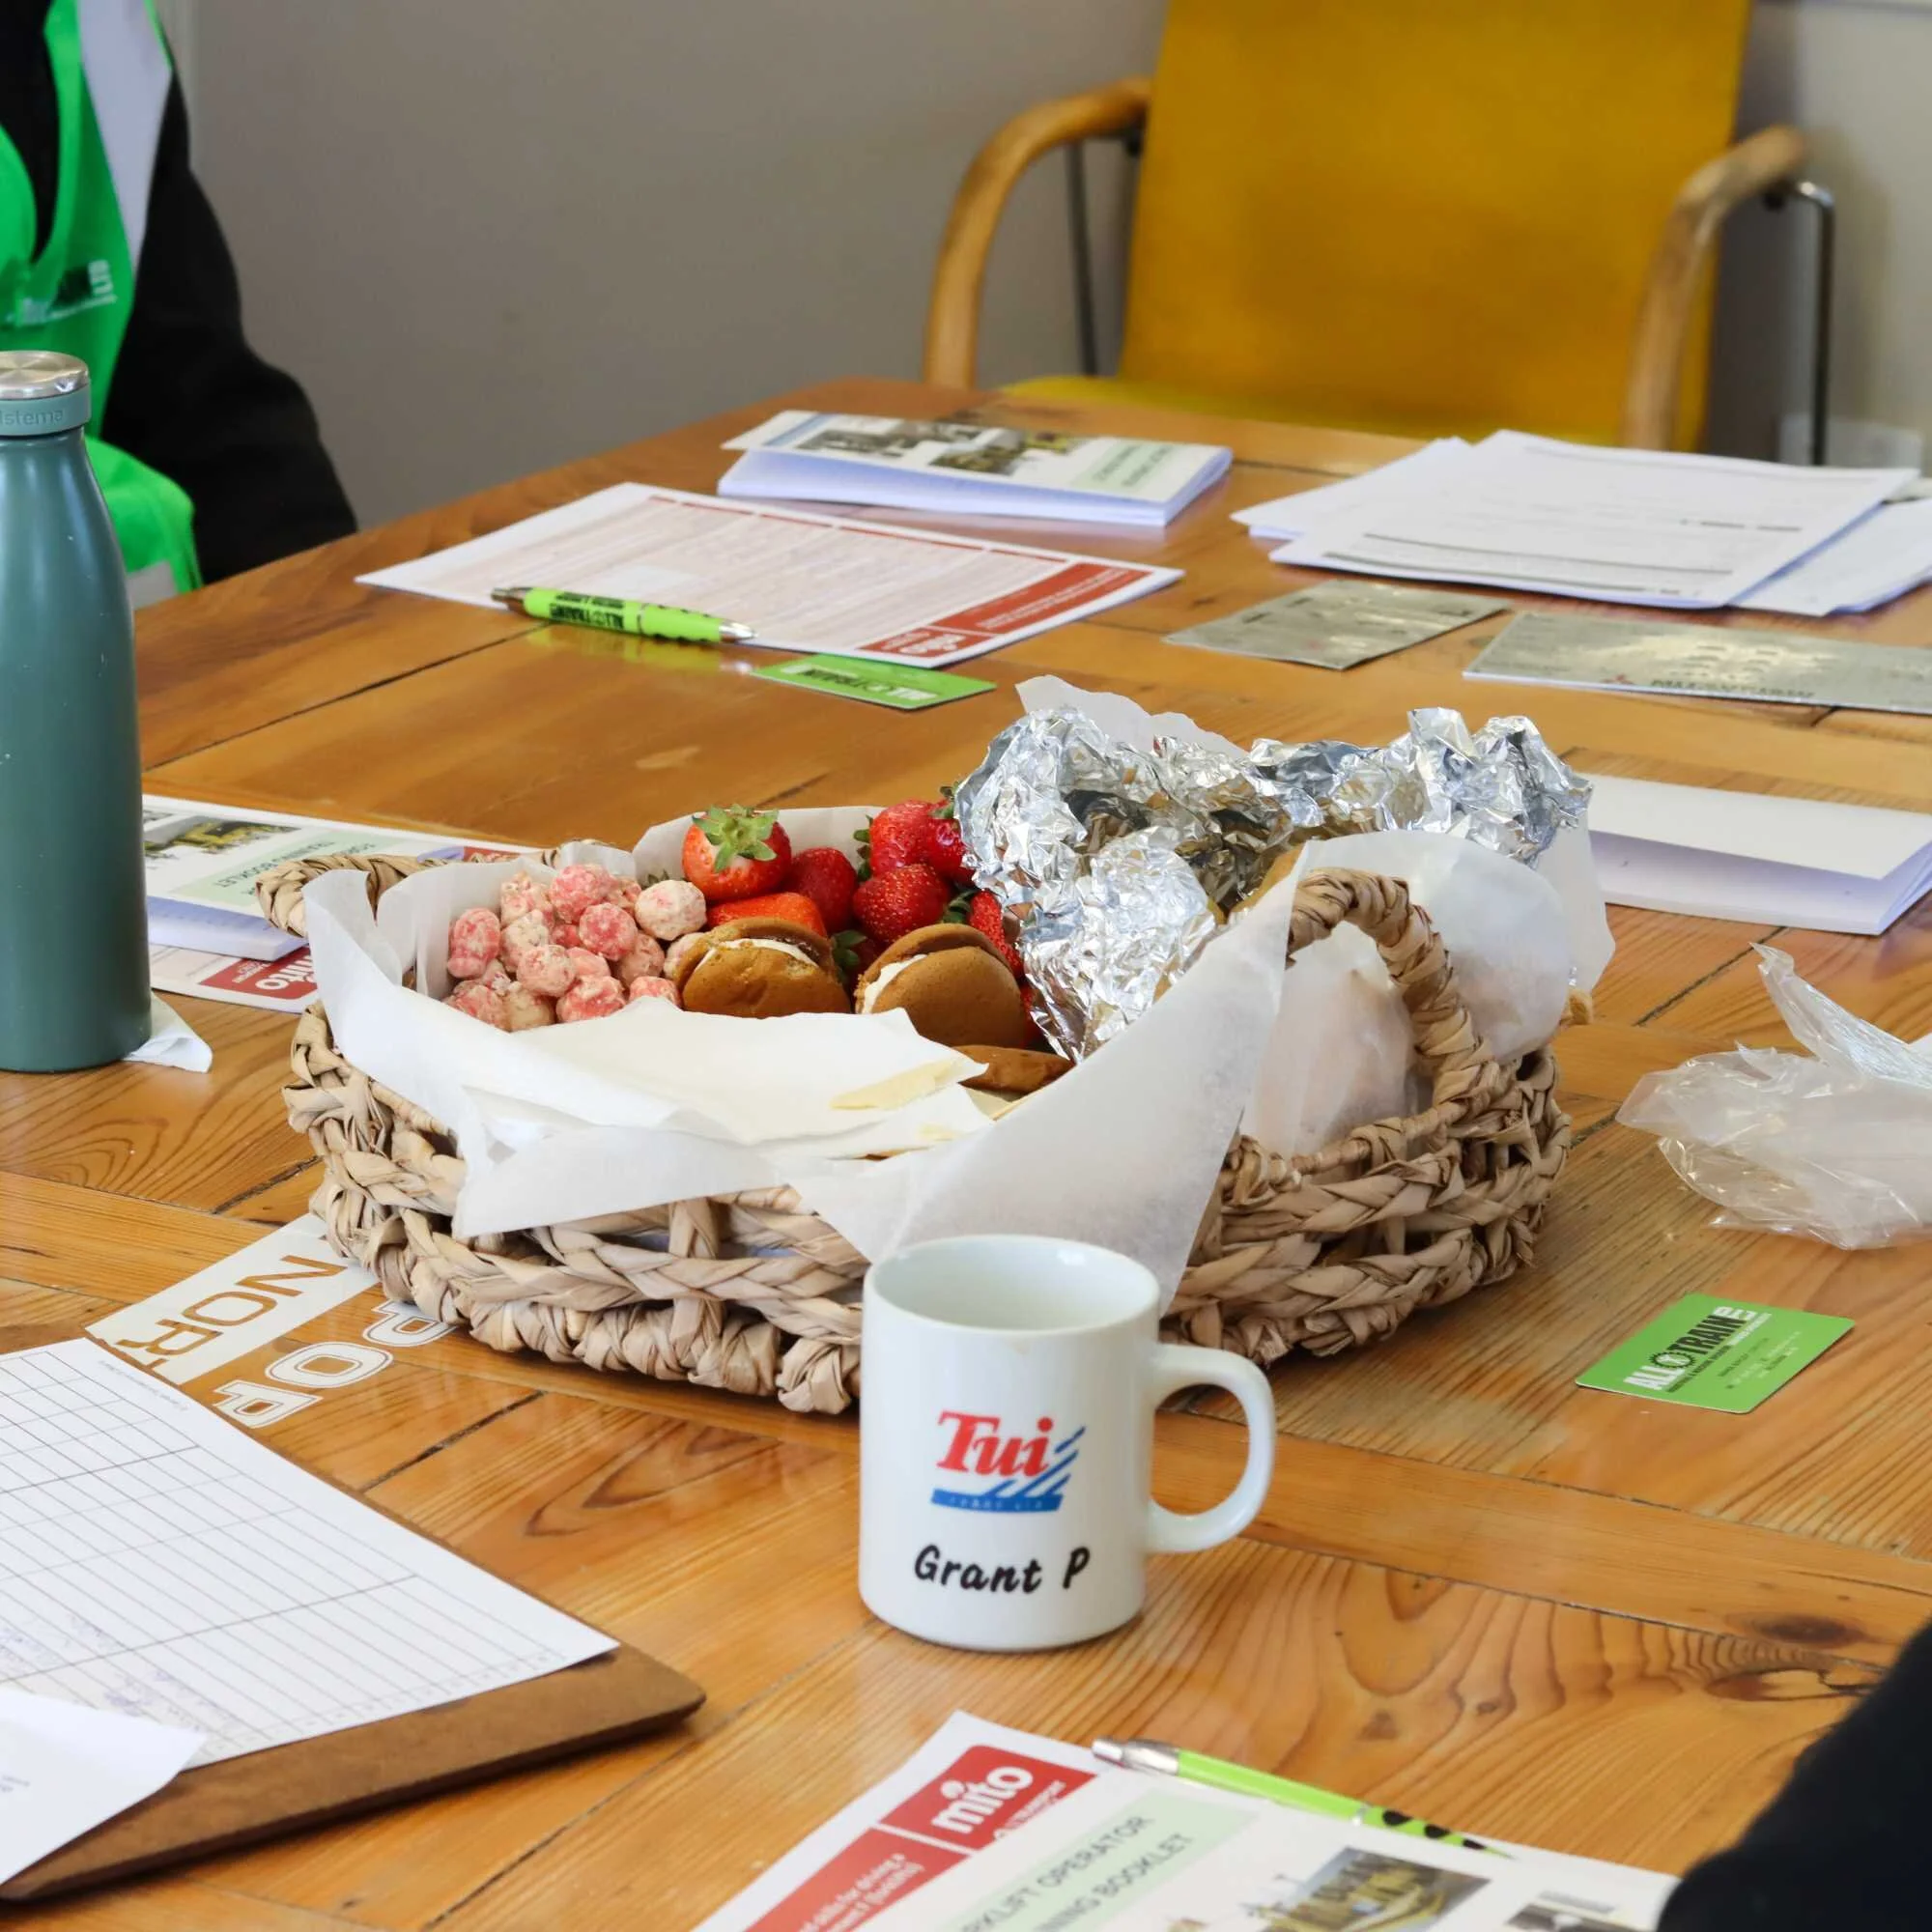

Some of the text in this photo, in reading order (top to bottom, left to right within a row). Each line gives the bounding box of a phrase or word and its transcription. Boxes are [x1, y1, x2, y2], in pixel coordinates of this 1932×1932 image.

[935, 1409, 1054, 1478] Tui
[913, 1544, 1092, 1594] Grant P
[930, 1765, 1034, 1834] mito
[1037, 1816, 1156, 1888] OPERATOR
[1092, 1833, 1194, 1897] BOOKLET
